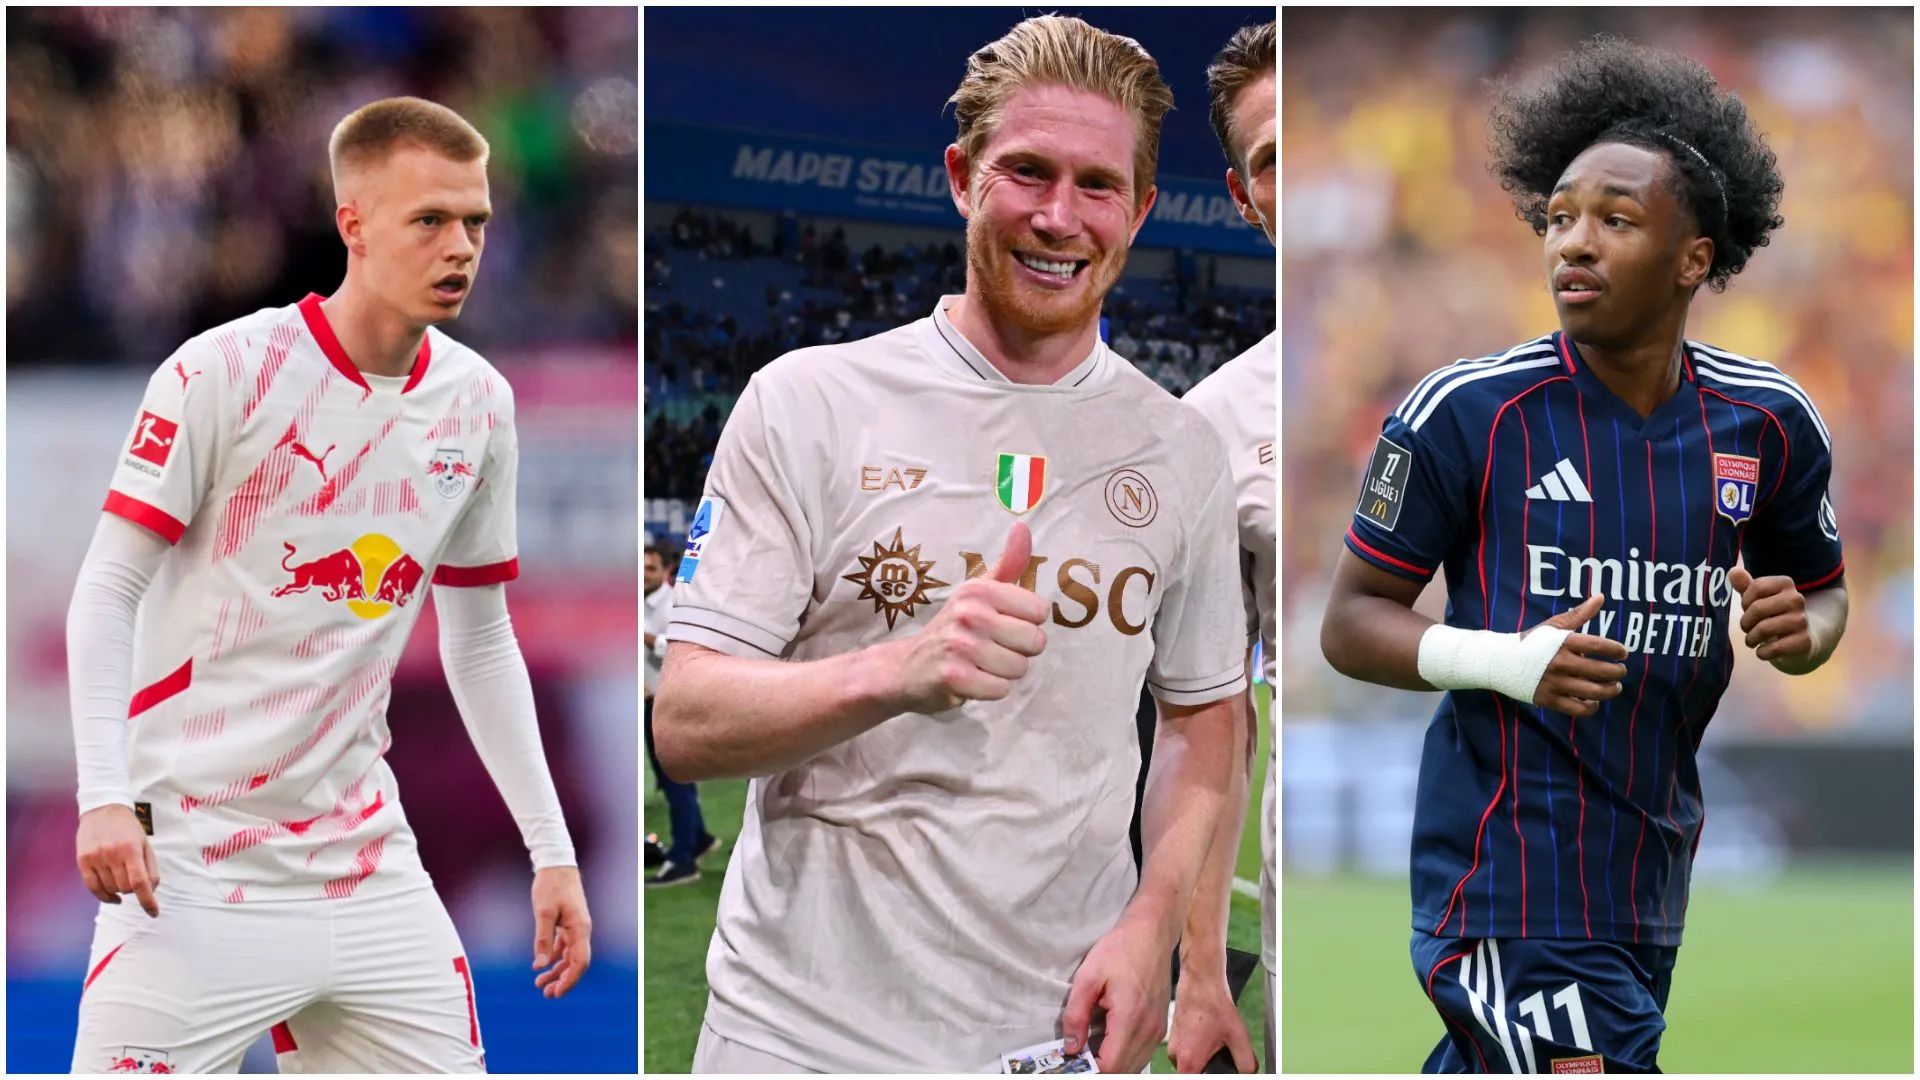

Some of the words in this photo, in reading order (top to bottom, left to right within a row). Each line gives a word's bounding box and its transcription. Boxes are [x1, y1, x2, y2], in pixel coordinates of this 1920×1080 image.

[732, 145, 854, 189] MAPEI
[860, 466, 929, 492] EA7
[1719, 459, 1757, 472] OLYMPIQUE
[1719, 467, 1756, 480] LYONNAIS
[1121, 483, 1144, 514] N
[1526, 543, 1733, 609] Emirates
[1624, 611, 1713, 658] BETTER
[1518, 982, 1594, 1052] 11
[1555, 1060, 1599, 1070] OLYMPIQUE
